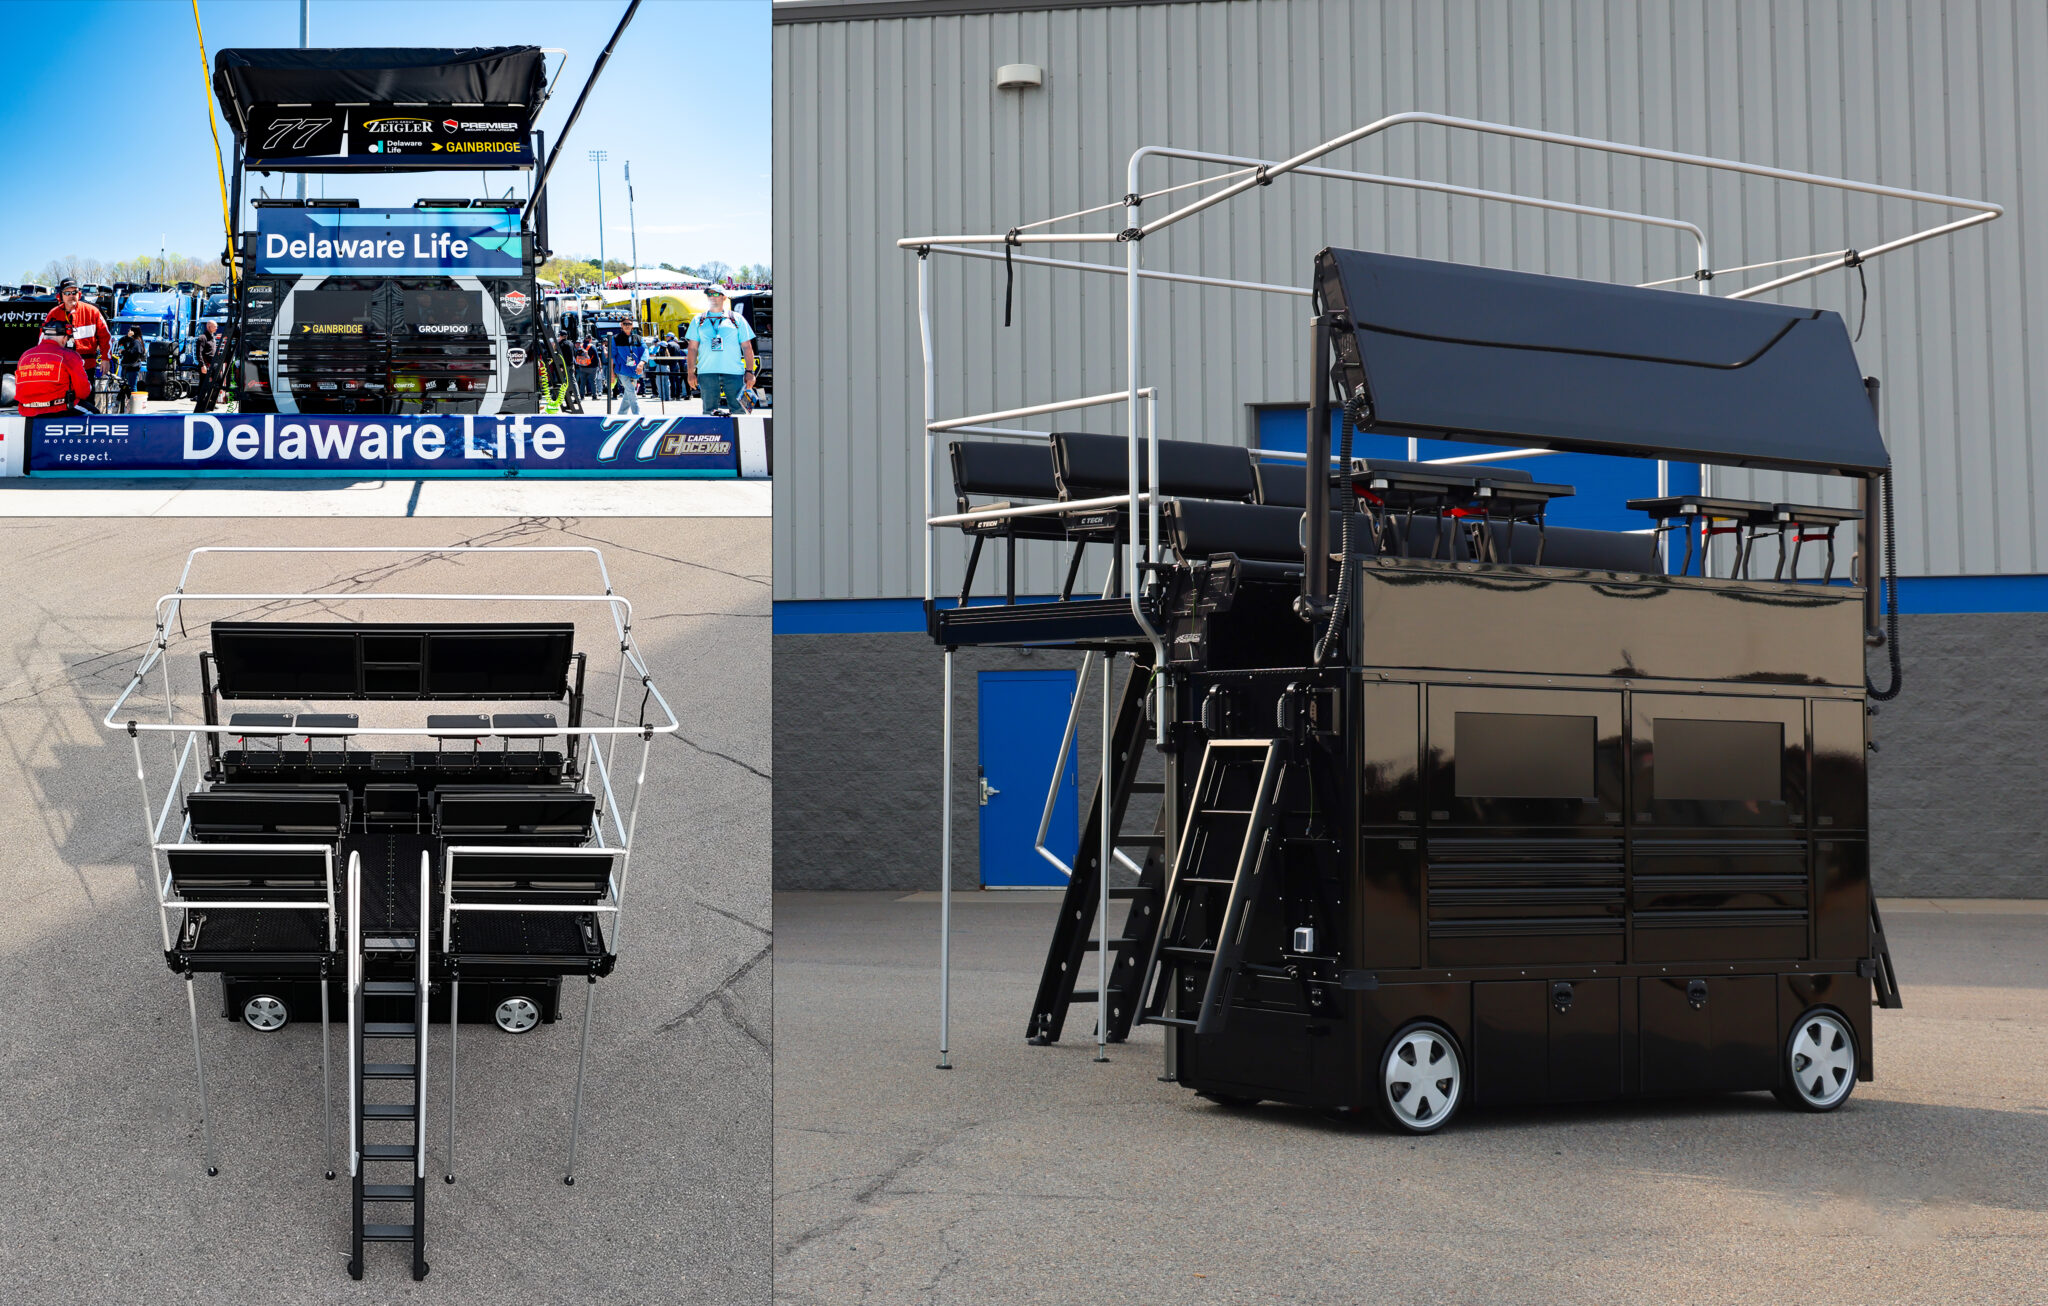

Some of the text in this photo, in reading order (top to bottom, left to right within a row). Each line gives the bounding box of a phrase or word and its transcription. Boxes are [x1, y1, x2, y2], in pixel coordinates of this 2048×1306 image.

[368, 121, 434, 133] ZEIGLER
[262, 118, 332, 150] 77
[446, 141, 521, 153] GAINBRIDGE
[266, 232, 468, 259] Delaware Life
[0, 311, 48, 322] MONSTE
[312, 324, 363, 334] GAINBRIDGE
[418, 325, 468, 333] GROUP1001
[44, 416, 129, 436] SPIRE
[183, 414, 721, 464] Delaware Life 77 CARSON
[660, 434, 732, 456] HOCEVAR
[59, 451, 112, 464] respect.
[983, 520, 998, 528] TECH
[1086, 516, 1104, 524] TECH
